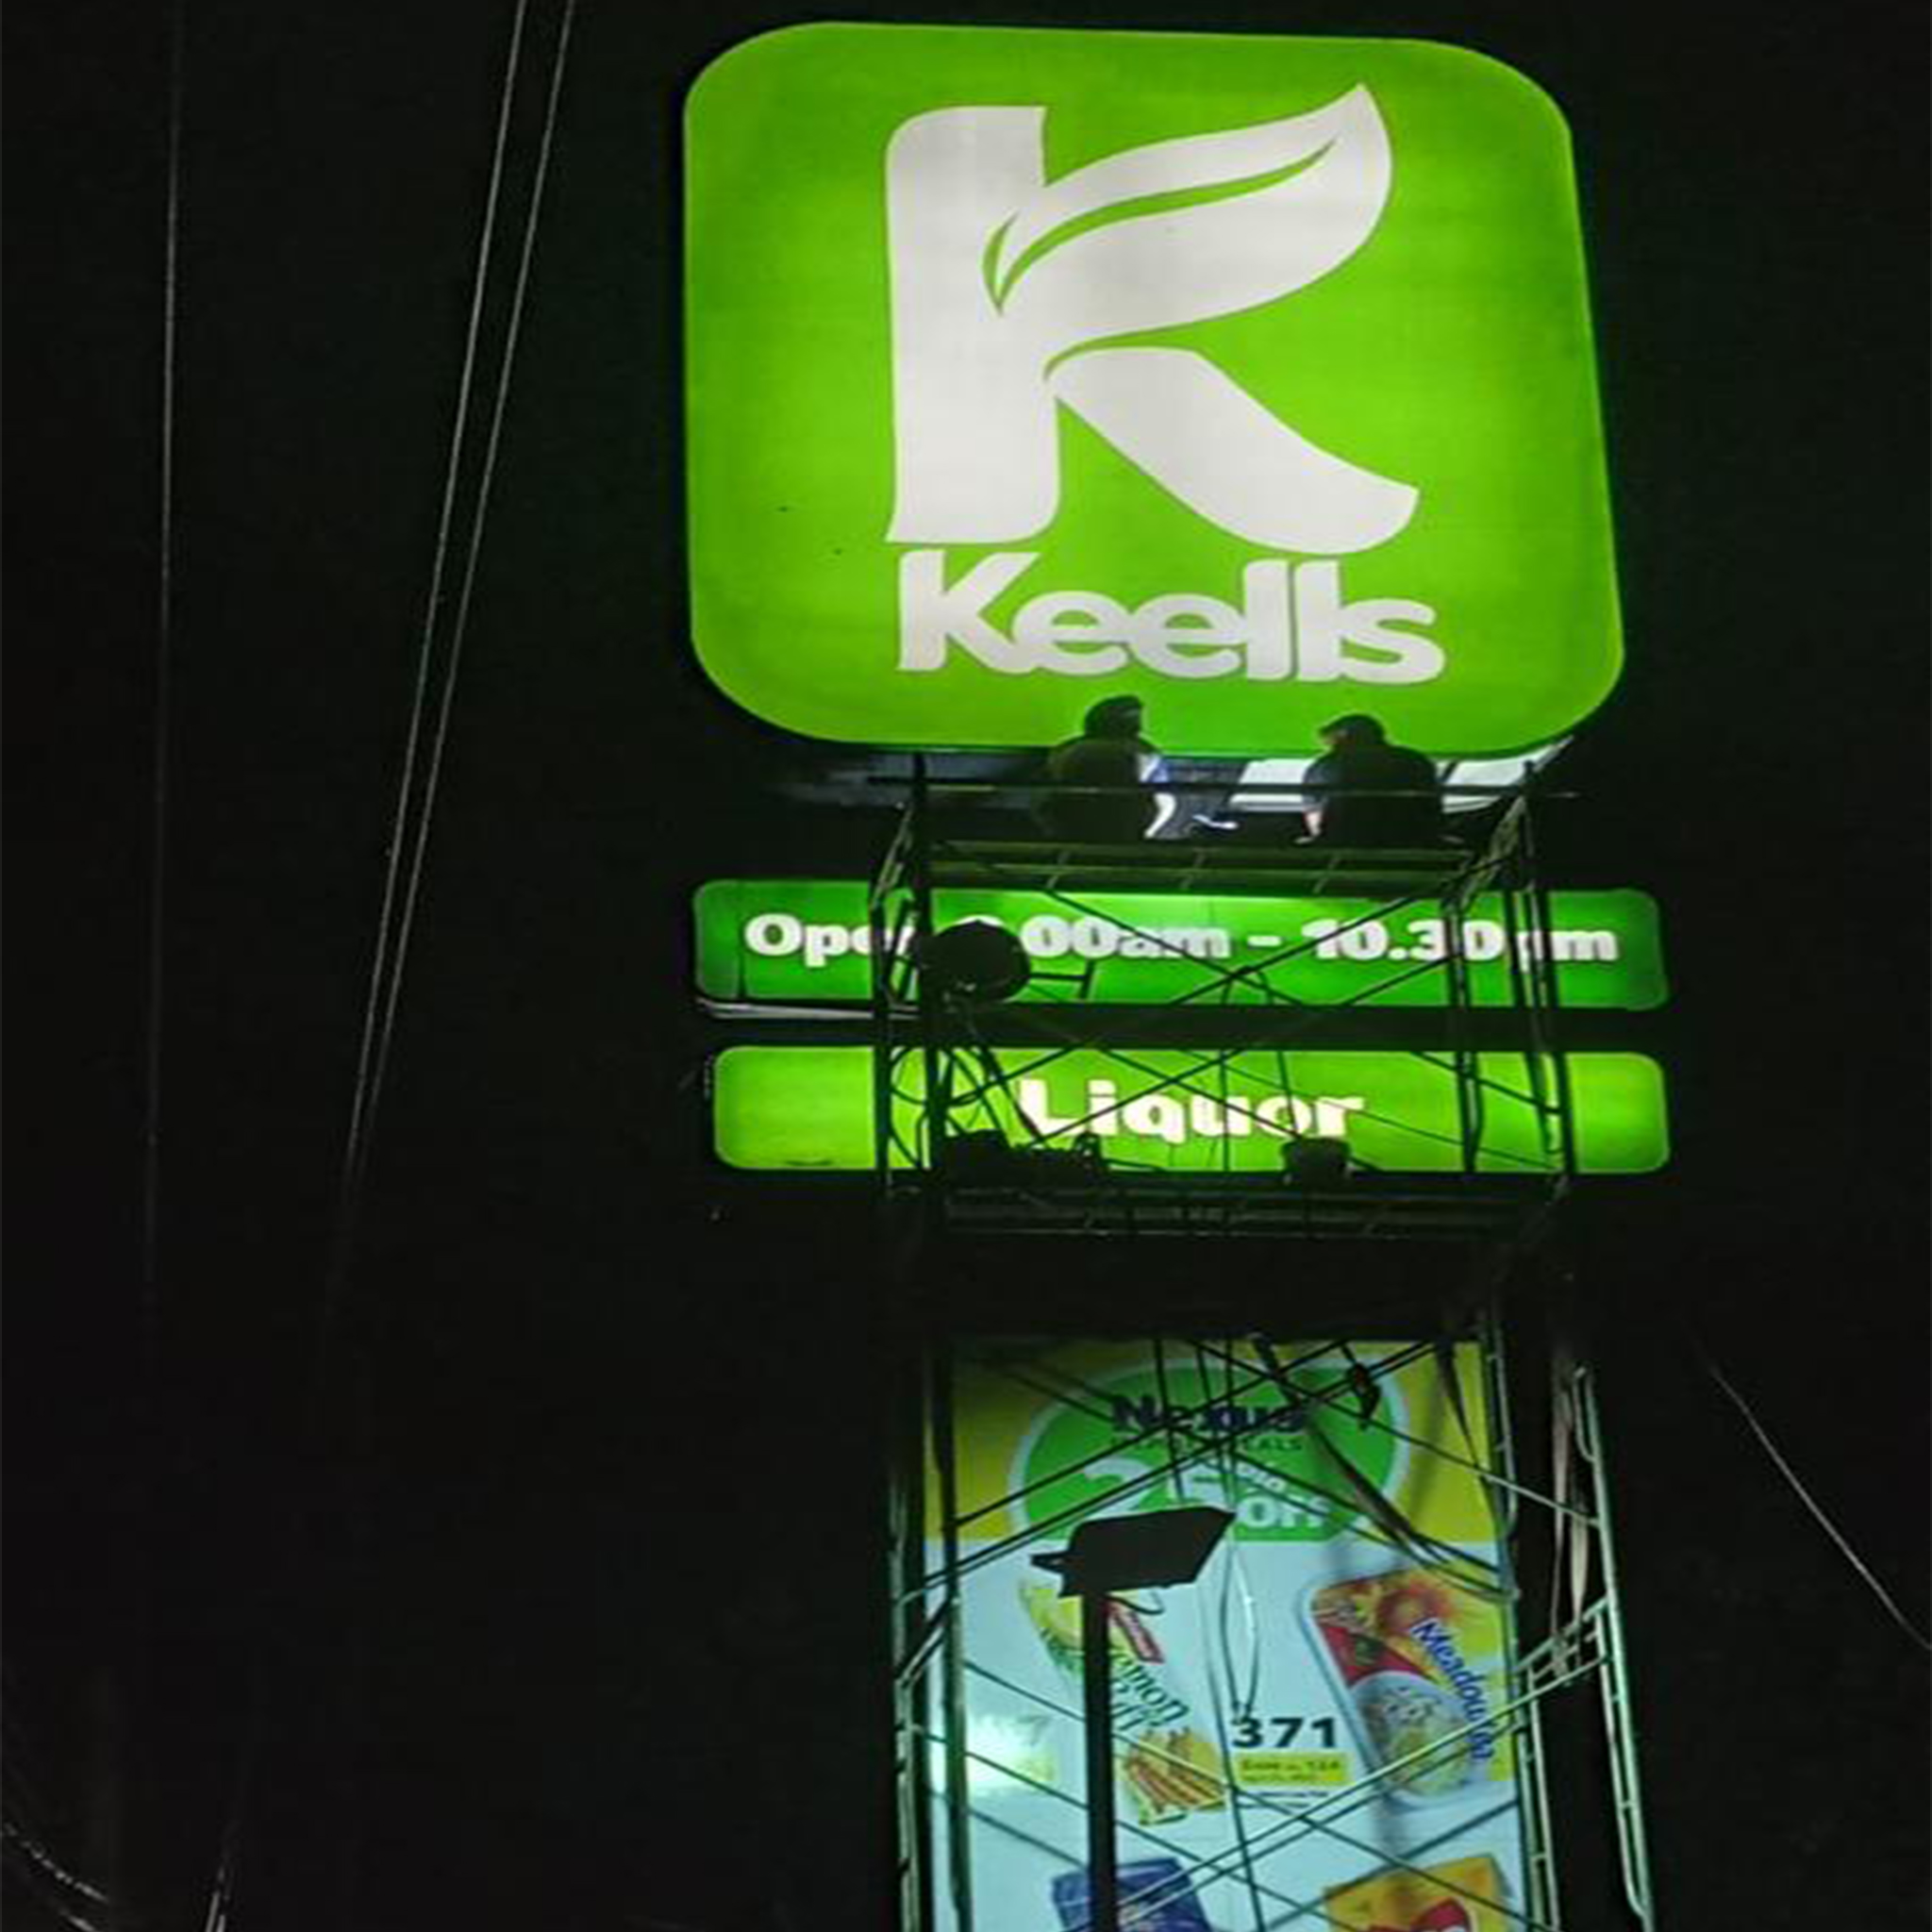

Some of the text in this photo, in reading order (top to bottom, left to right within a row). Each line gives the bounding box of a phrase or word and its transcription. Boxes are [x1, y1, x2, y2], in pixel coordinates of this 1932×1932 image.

[896, 548, 1446, 684] Keells
[1019, 1078, 1365, 1143] Liquor
[1230, 1717, 1335, 1749] 371
